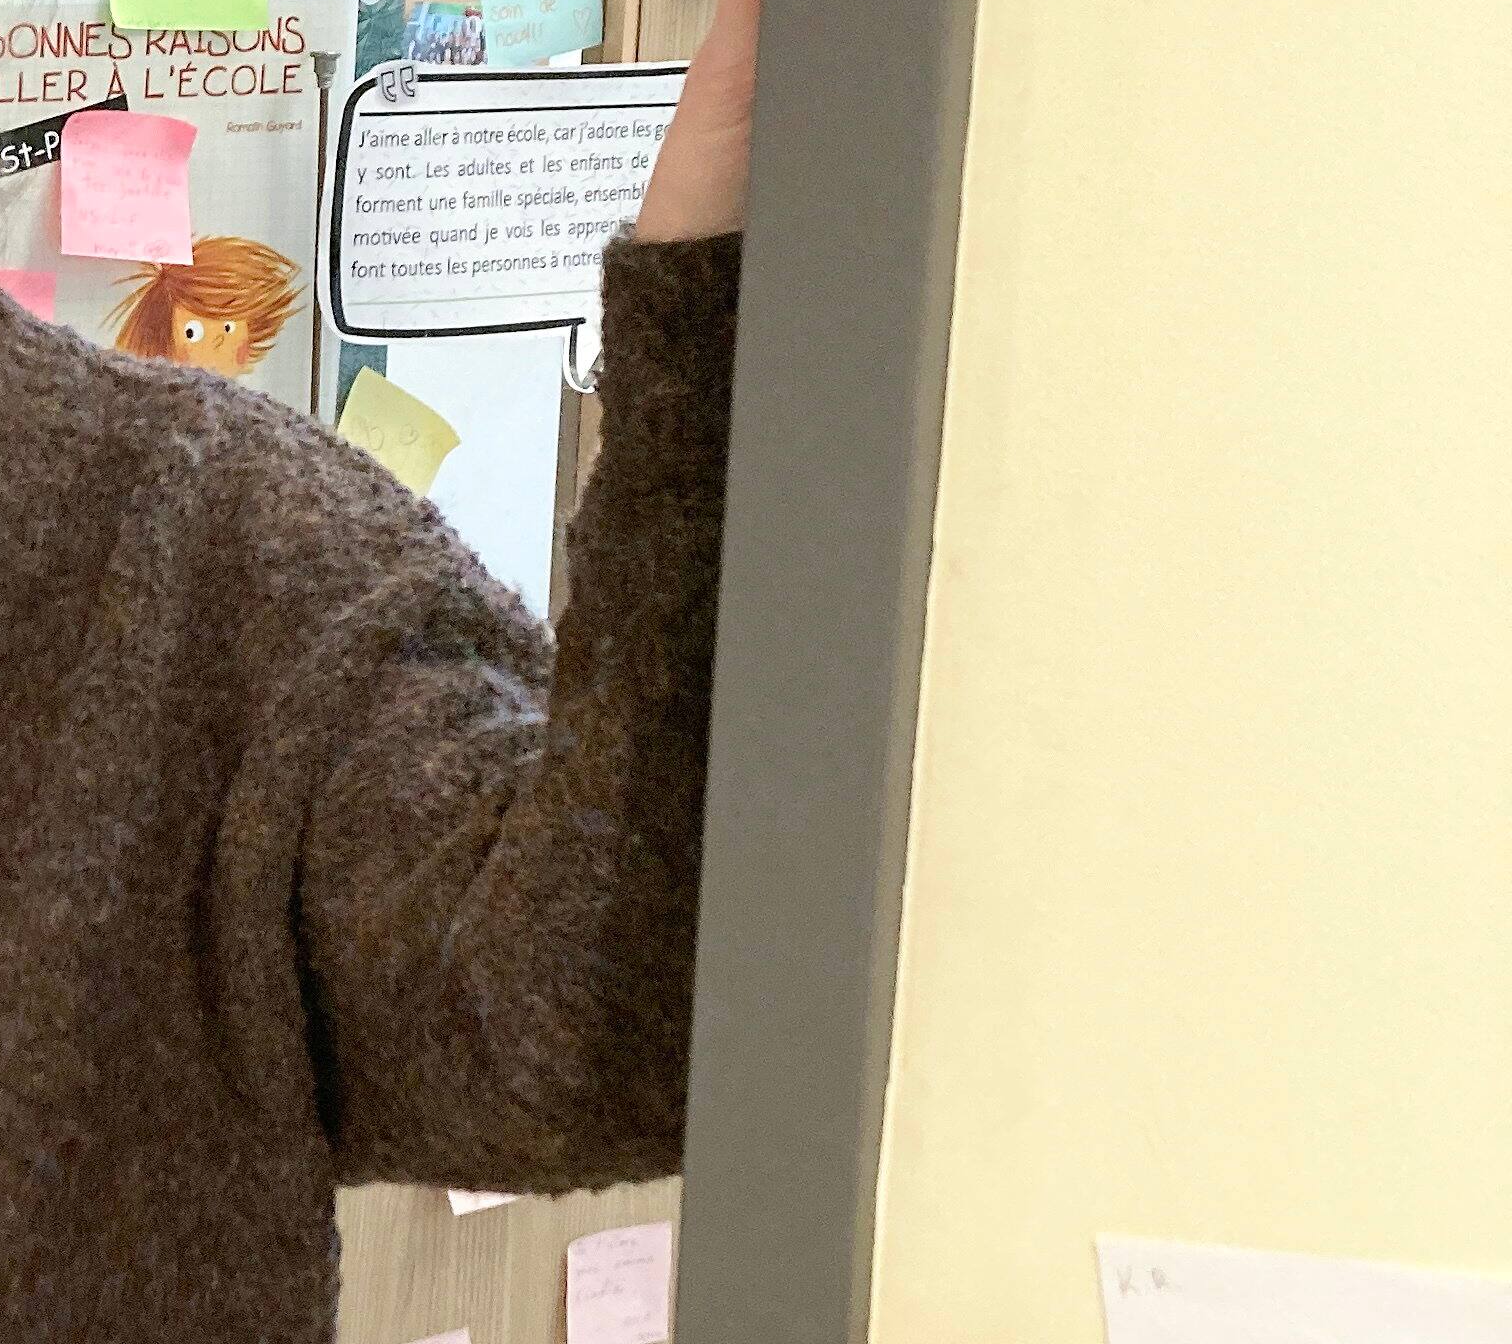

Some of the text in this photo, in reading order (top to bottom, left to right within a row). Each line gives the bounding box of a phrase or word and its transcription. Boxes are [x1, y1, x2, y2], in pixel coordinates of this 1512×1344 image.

[145, 15, 308, 58] RAISONS
[106, 60, 126, 100] À
[144, 59, 304, 99] L'ÉCOLE
[358, 127, 411, 149] J'aime
[413, 127, 450, 147] aller
[451, 129, 461, 145] à
[463, 126, 504, 145] notre
[506, 123, 551, 145] école,
[553, 125, 576, 142] car
[577, 121, 630, 144] j'adore
[631, 119, 653, 139] les
[356, 151, 650, 185] y sont. Les adultes et les enfants de
[354, 193, 424, 214] forment
[428, 195, 457, 212] une
[462, 189, 513, 210] famille
[516, 186, 579, 209] spéciale,
[352, 224, 421, 246] motivée
[428, 223, 478, 246] quand
[484, 224, 499, 245] je
[504, 221, 534, 238] vois
[540, 219, 561, 237] les
[350, 250, 603, 280] font toutes les personnes à notre
